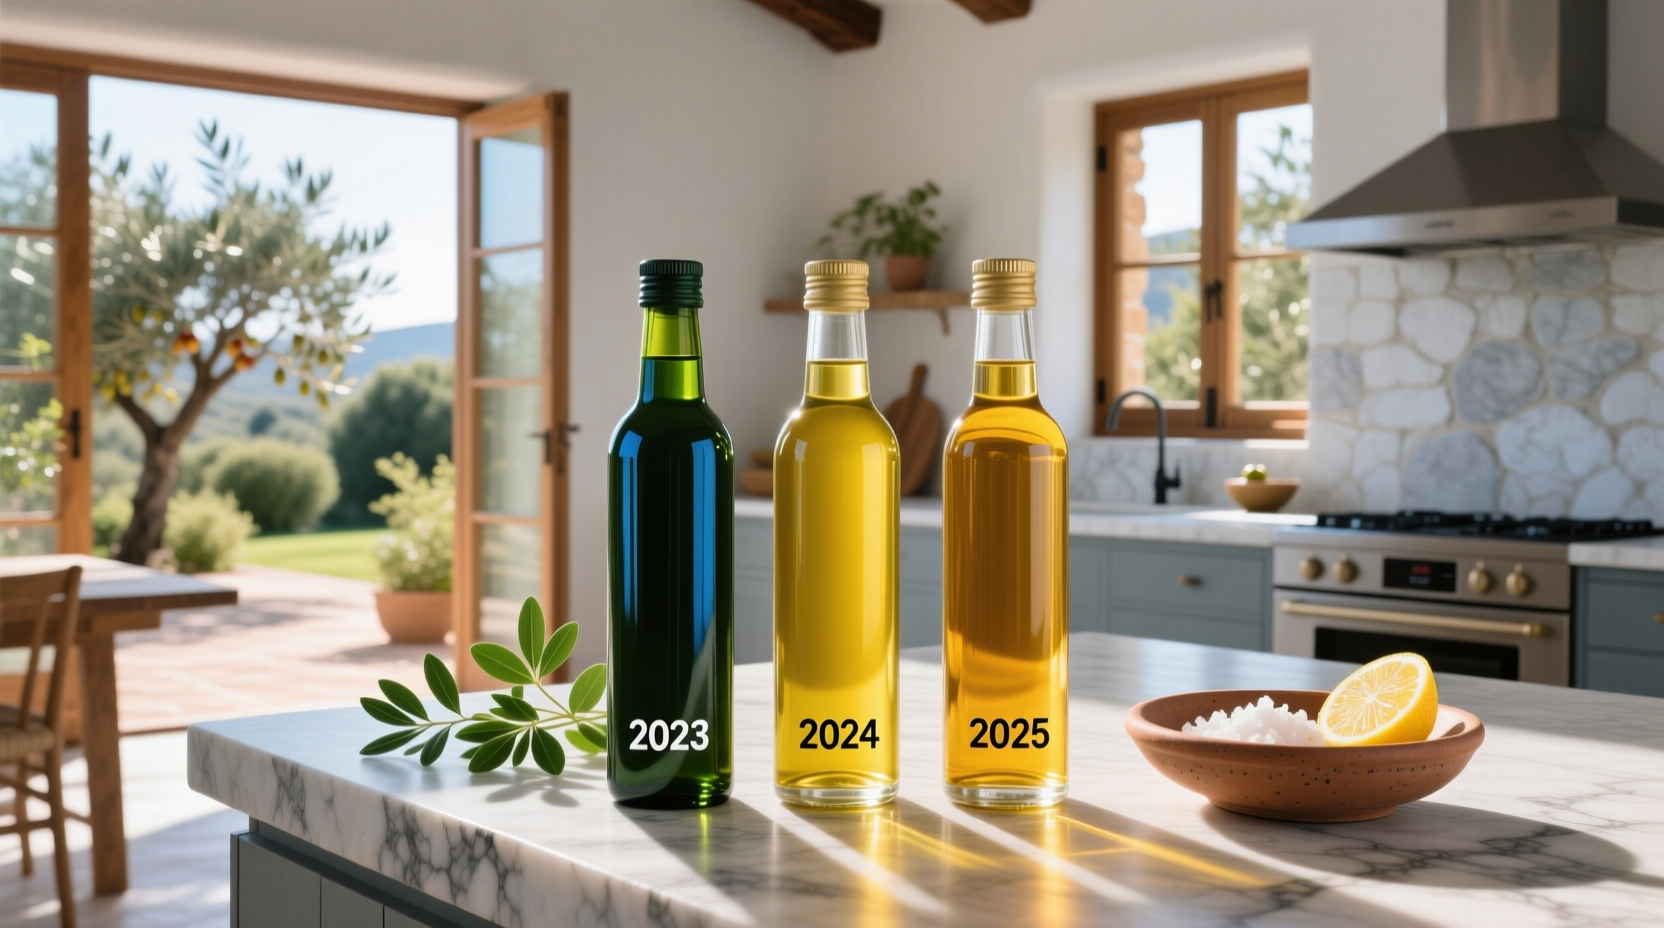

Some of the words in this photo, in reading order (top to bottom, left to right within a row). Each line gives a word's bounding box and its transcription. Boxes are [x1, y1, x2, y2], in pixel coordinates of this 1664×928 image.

[629, 718, 709, 751] 2023
[799, 718, 880, 750] 2024
[969, 717, 1050, 749] 2025
